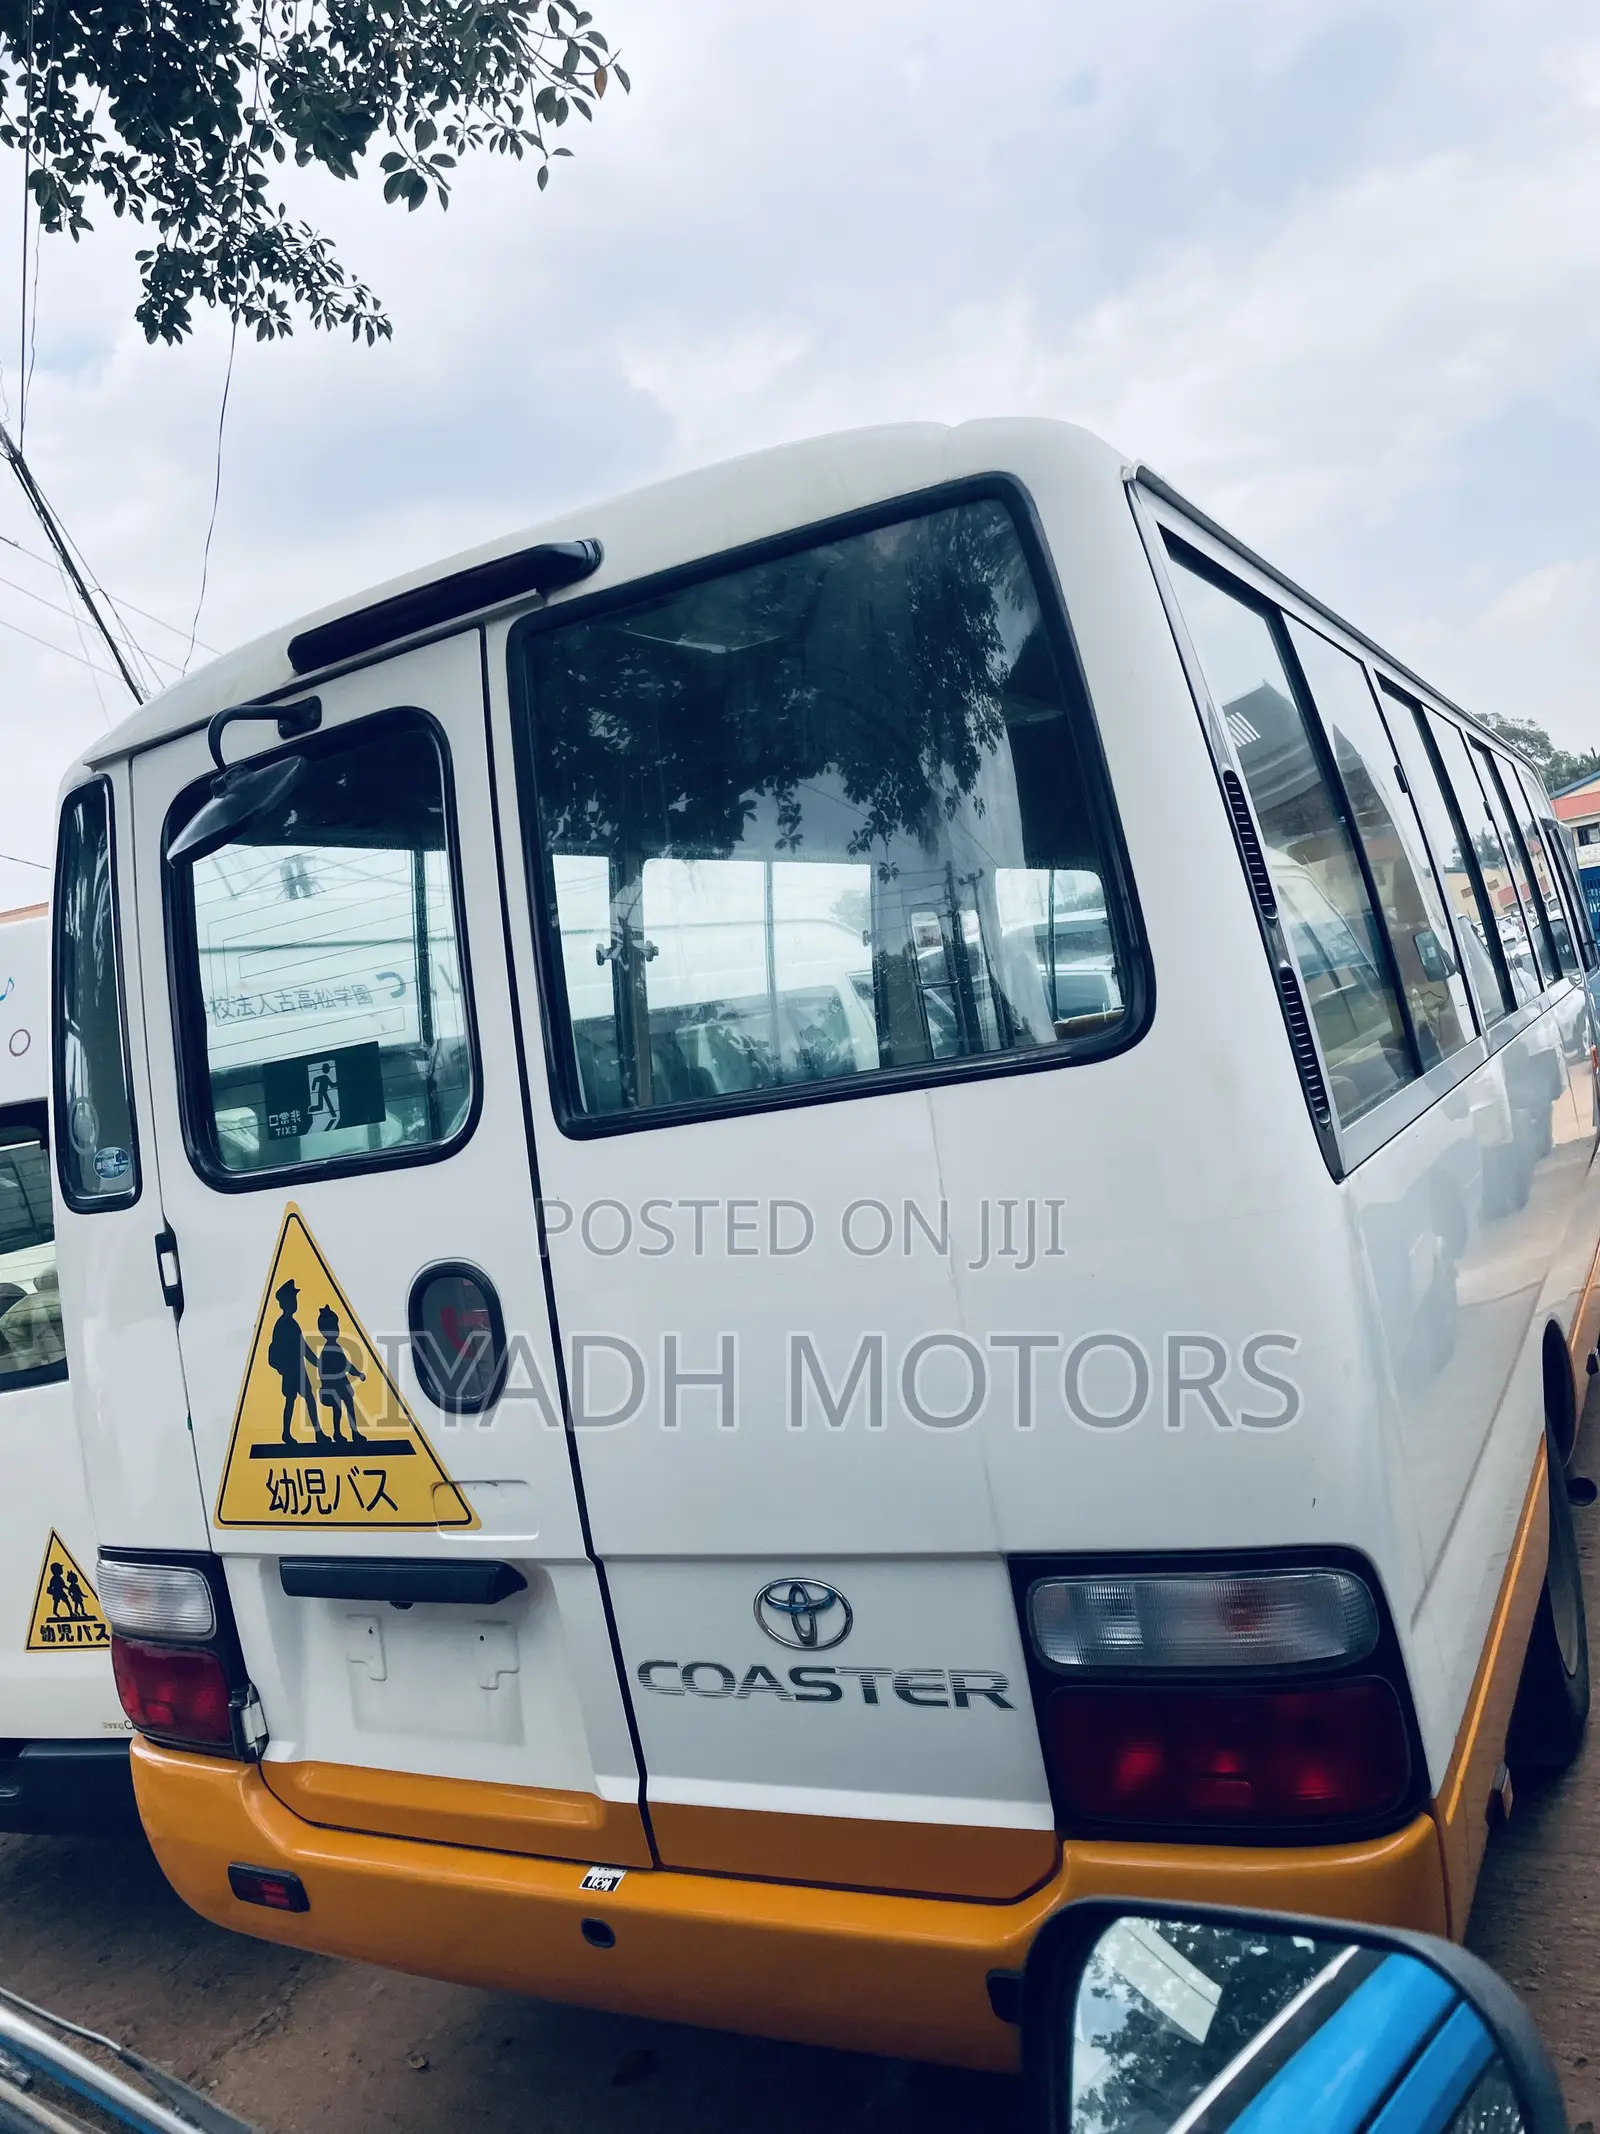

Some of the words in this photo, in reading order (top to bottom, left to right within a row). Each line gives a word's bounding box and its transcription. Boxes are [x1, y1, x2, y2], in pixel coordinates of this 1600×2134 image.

[205, 984, 373, 1020] 校法人古高松学園
[265, 1465, 399, 1516] 幼児バス
[40, 1623, 110, 1643] 幼児バス
[636, 1659, 1018, 1712] COASTER
